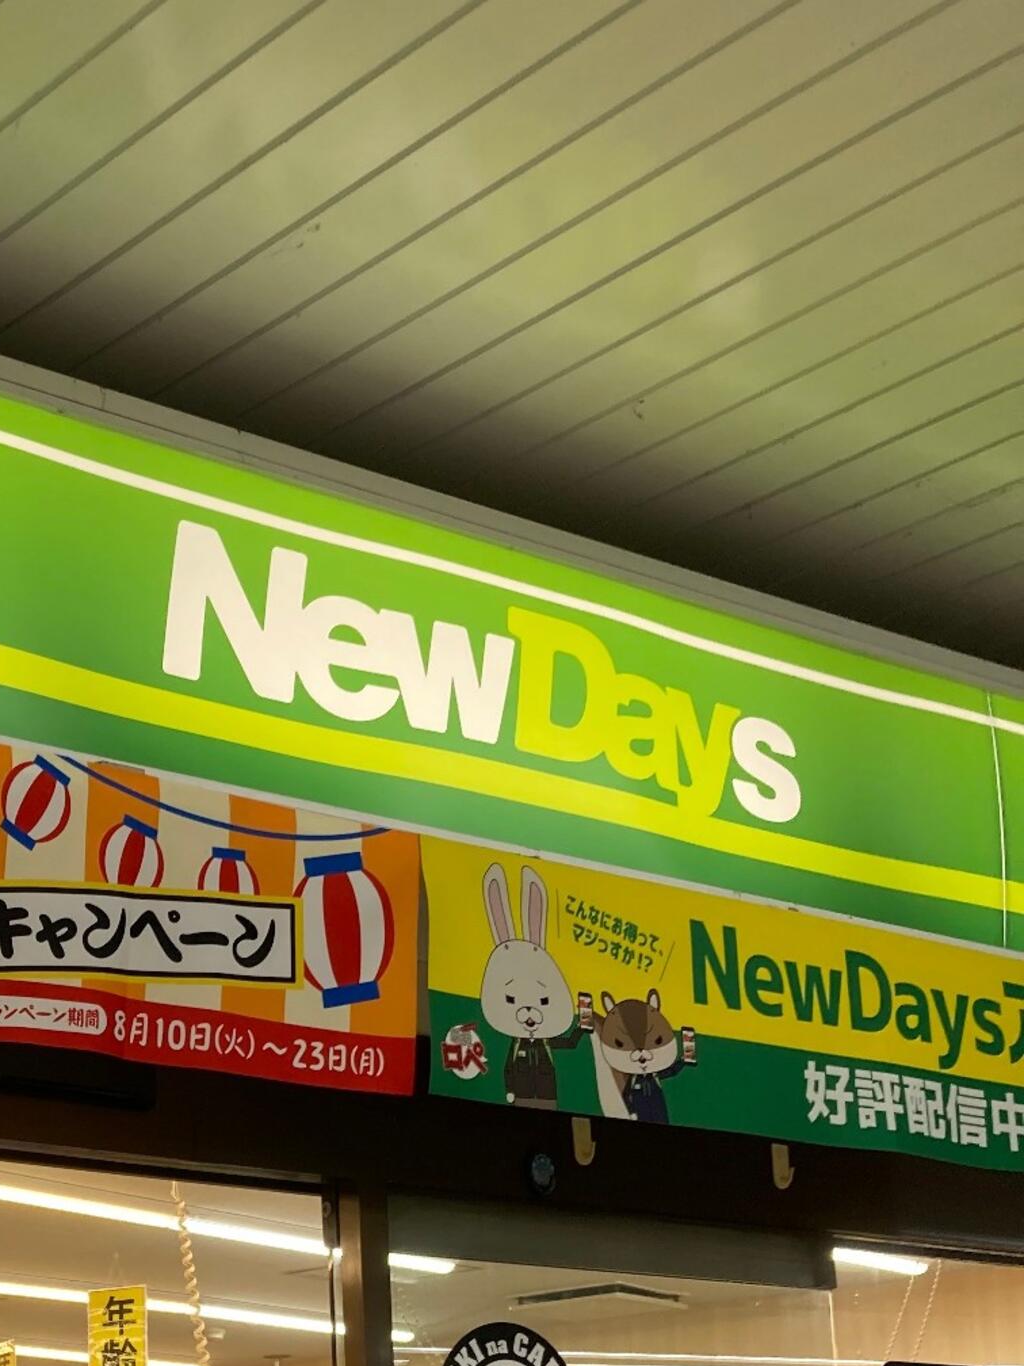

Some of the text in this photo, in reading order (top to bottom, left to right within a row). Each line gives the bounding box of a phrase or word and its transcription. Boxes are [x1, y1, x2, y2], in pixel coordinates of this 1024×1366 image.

[162, 519, 802, 824] NewDays
[804, 1060, 1024, 1152] 好評配信中
[485, 1339, 509, 1357] na
